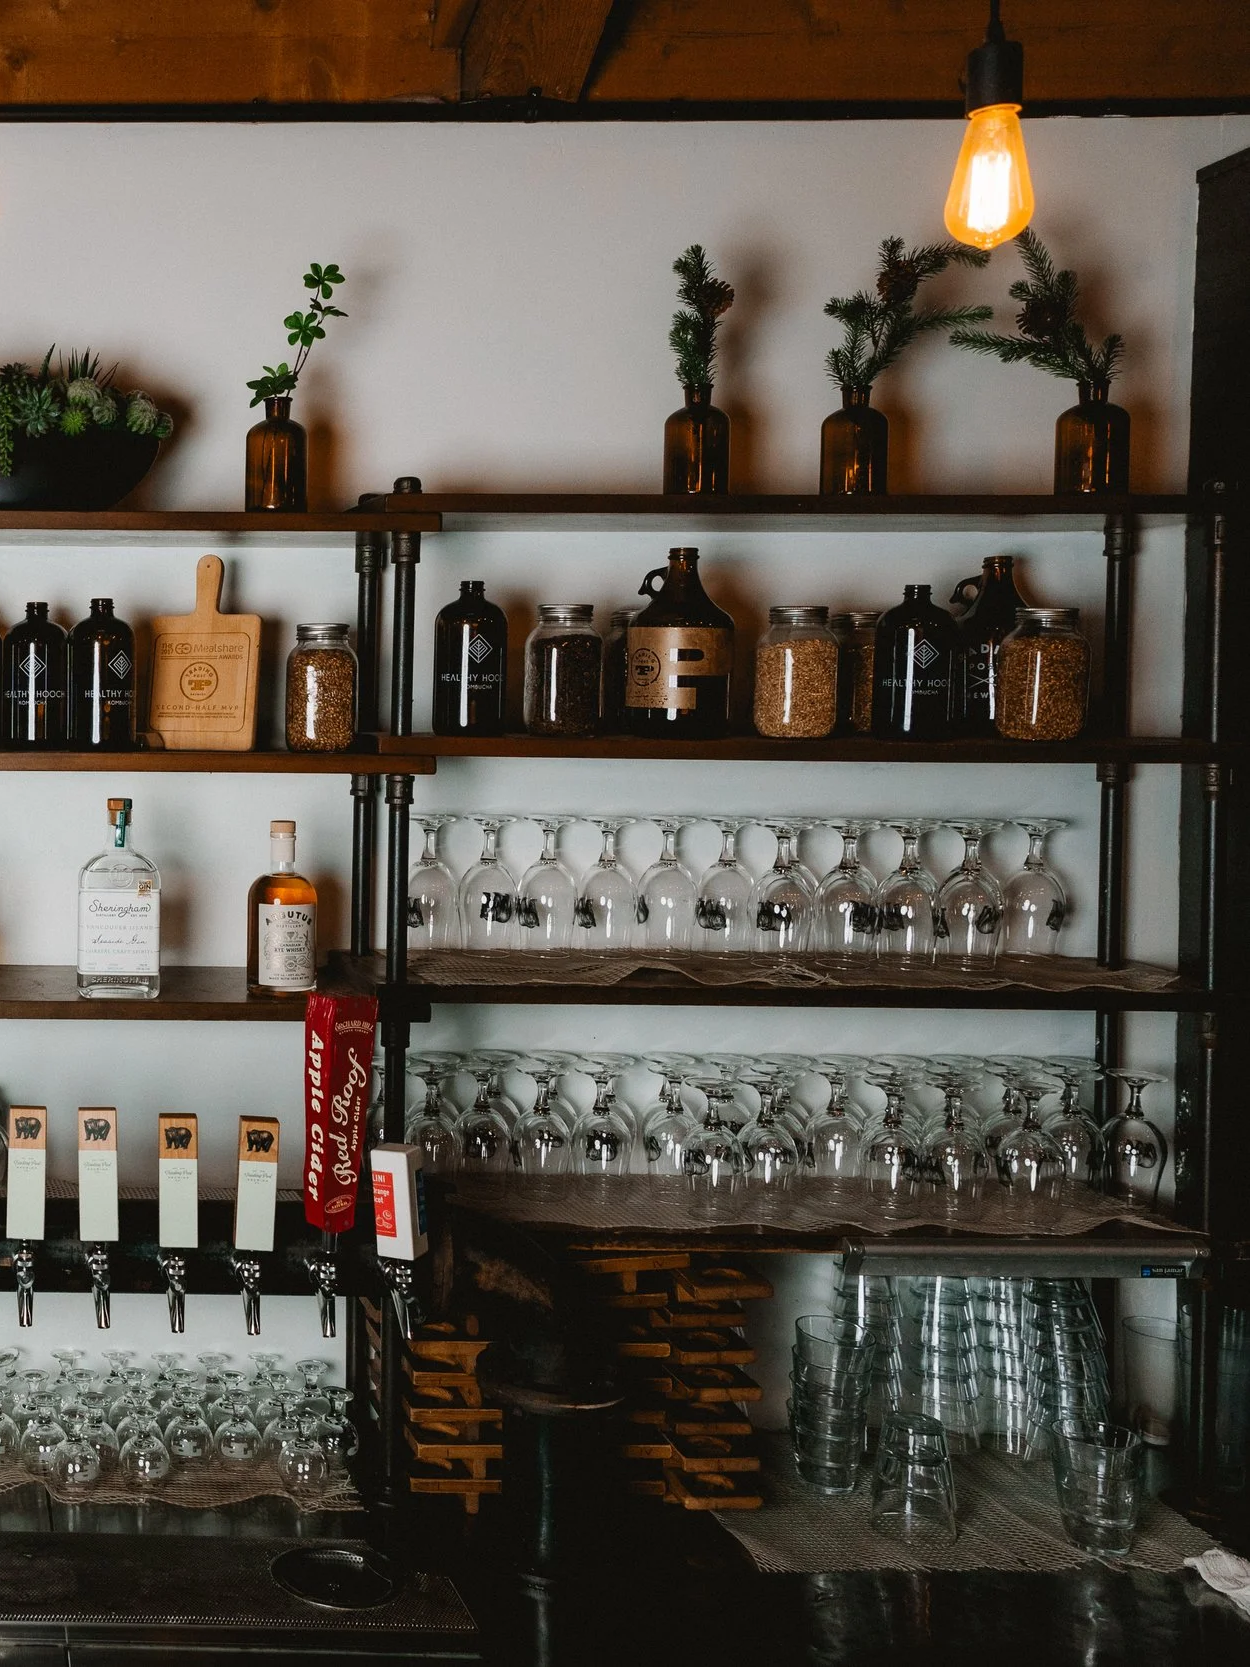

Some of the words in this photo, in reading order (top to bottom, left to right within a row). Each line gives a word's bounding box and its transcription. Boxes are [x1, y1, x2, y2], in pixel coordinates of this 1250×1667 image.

[193, 643, 244, 653] Mealshare
[185, 666, 214, 678] TRADING
[441, 673, 479, 682] HEALHY
[882, 679, 923, 688] HEALHY
[84, 689, 122, 698] HEALTHY
[88, 899, 152, 919] Sheringham
[308, 1029, 325, 1114] Apple
[330, 1047, 367, 1127] Roof
[353, 1096, 362, 1122] Cider
[350, 1124, 359, 1152] Apple
[307, 1123, 325, 1202] Cider
[328, 1130, 358, 1186] Red
